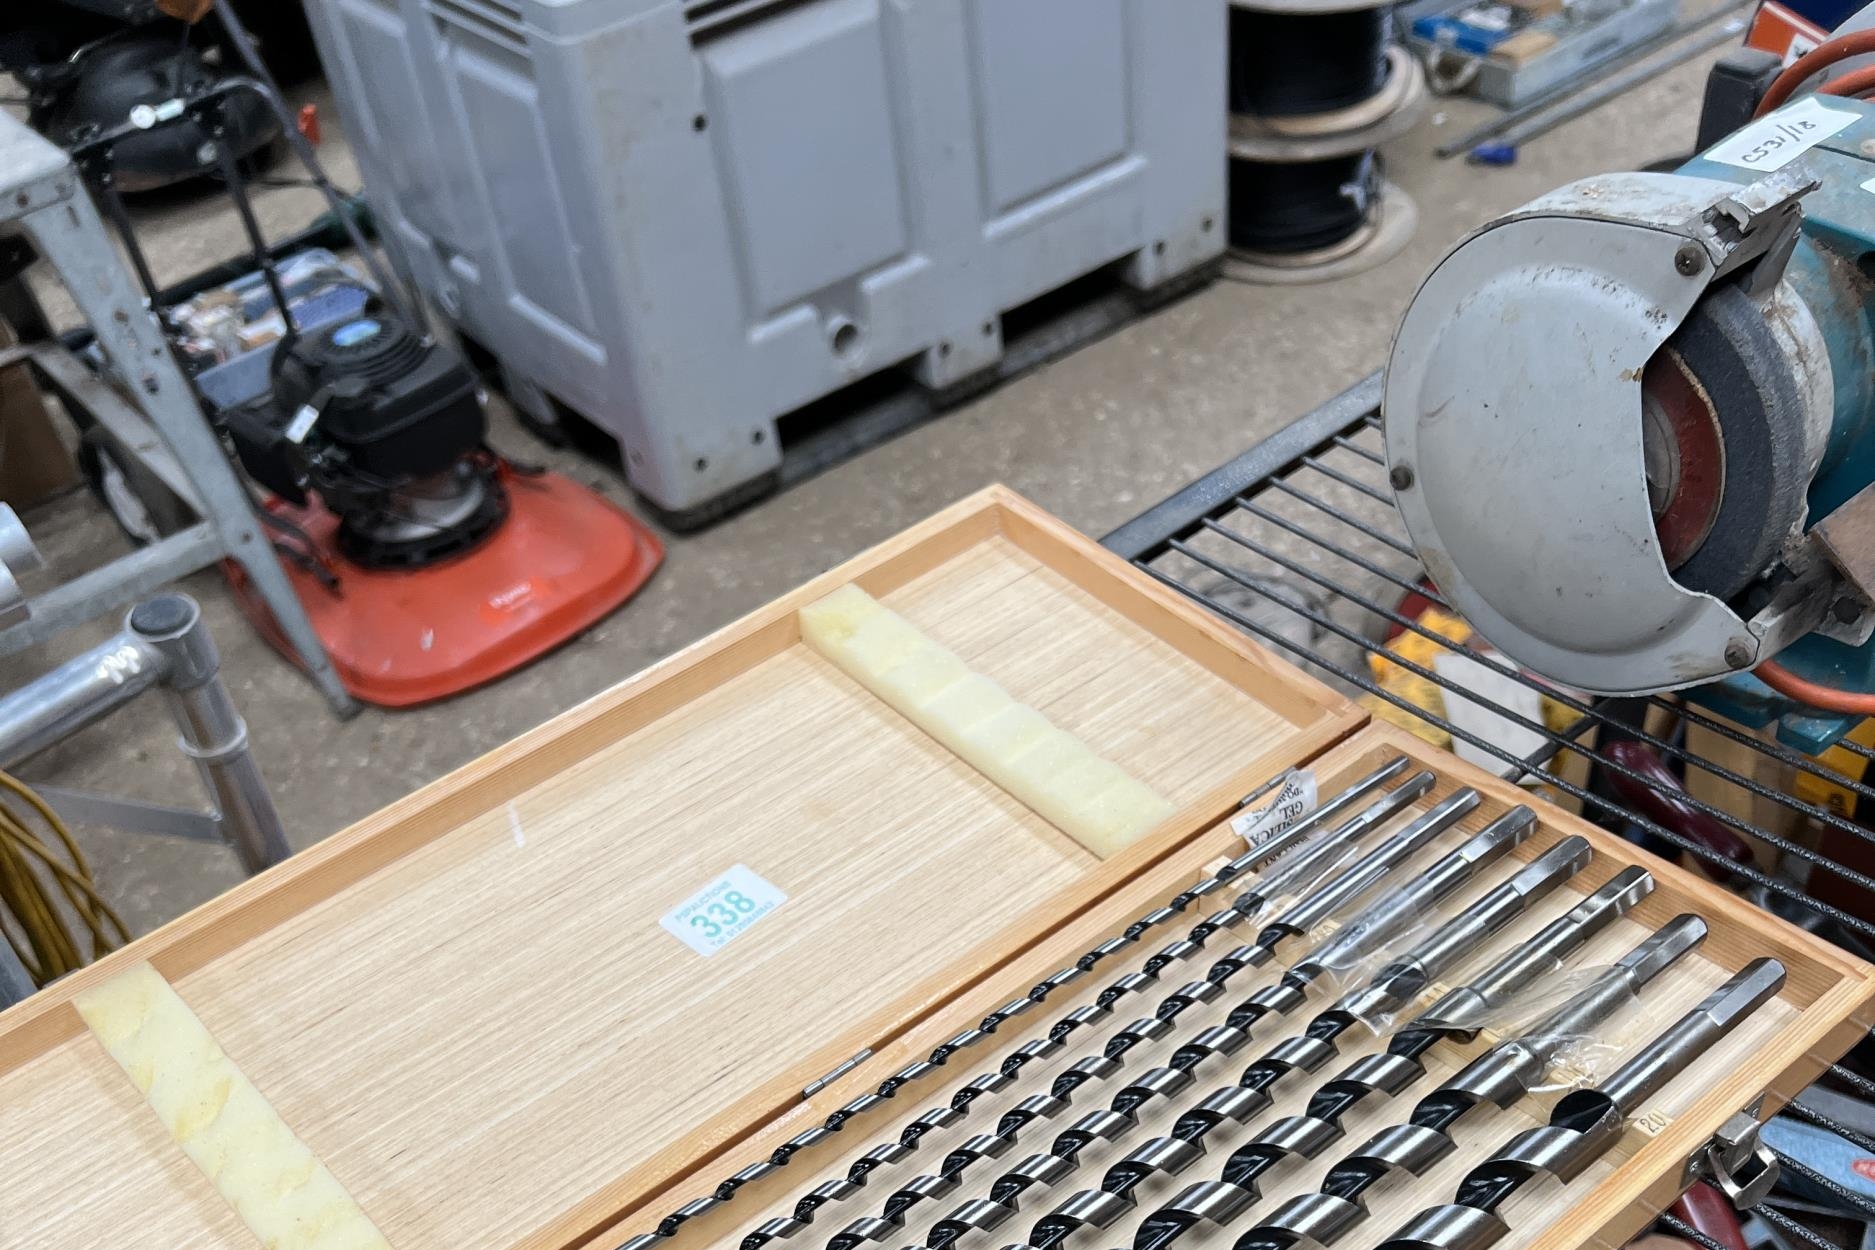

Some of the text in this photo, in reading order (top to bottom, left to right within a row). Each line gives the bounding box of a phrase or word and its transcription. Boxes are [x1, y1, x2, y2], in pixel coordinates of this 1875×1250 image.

[1281, 801, 1304, 820] GEL
[690, 890, 755, 938] 338
[1640, 1112, 1667, 1134] 20
